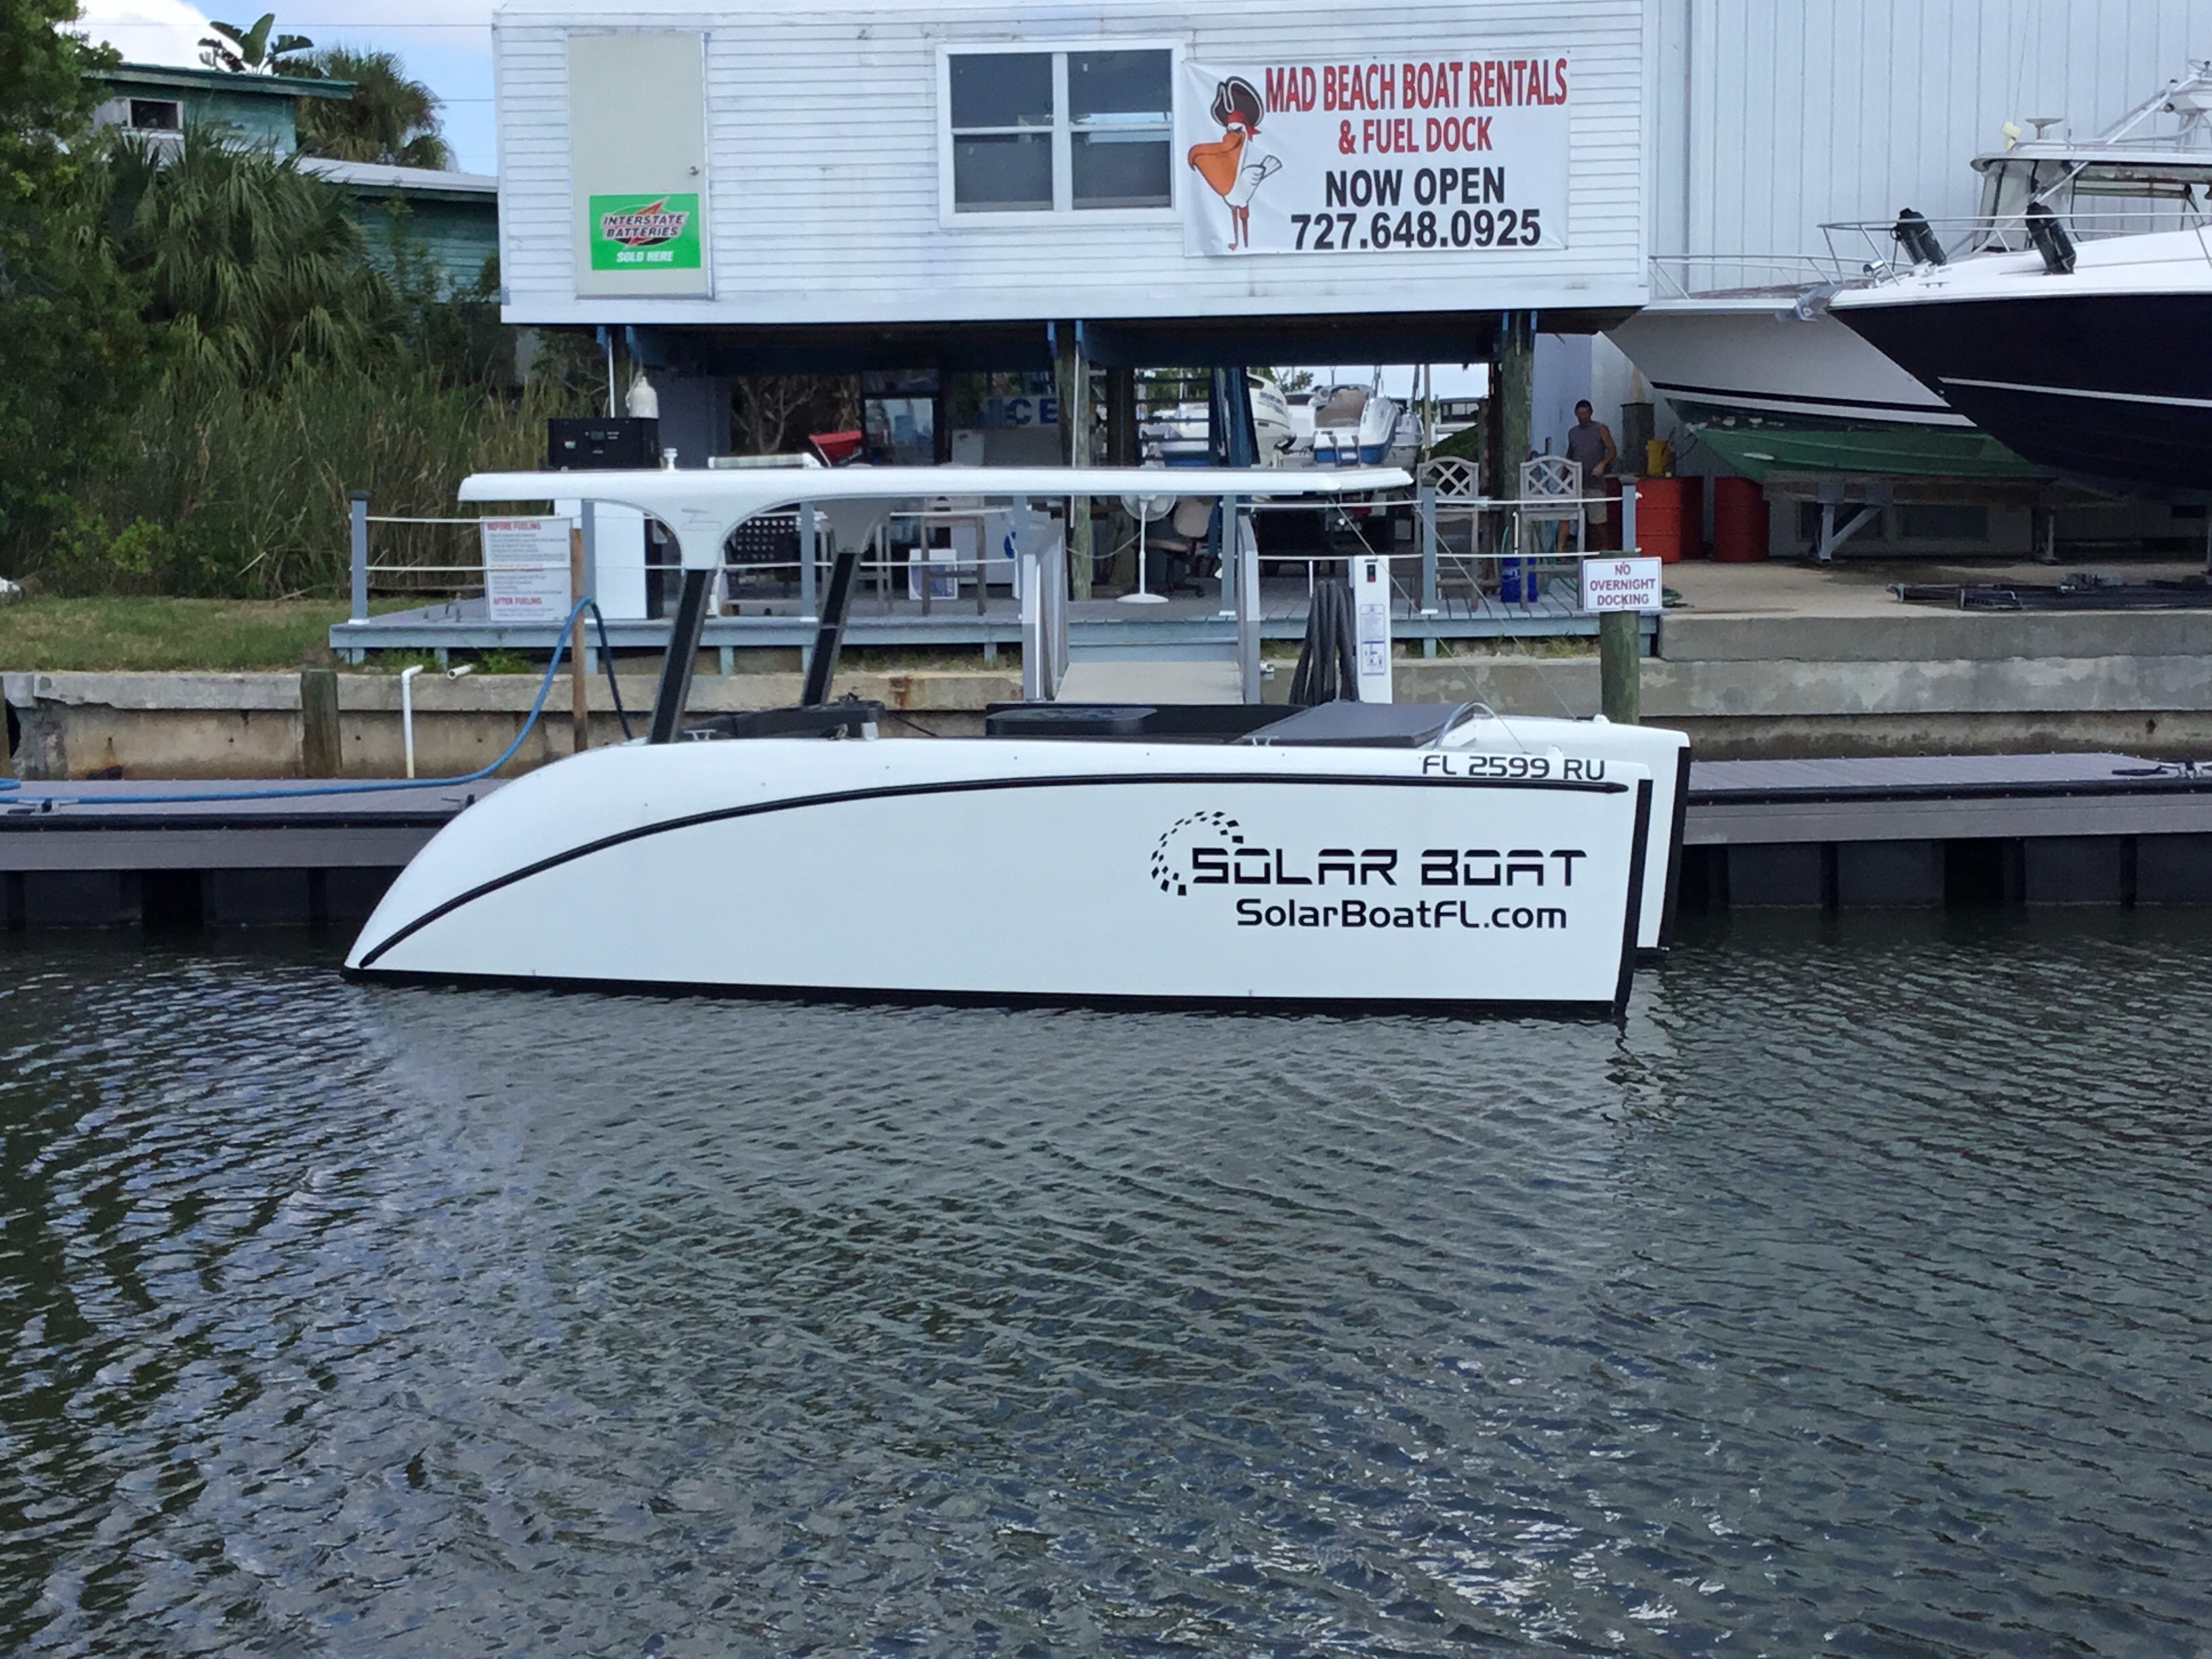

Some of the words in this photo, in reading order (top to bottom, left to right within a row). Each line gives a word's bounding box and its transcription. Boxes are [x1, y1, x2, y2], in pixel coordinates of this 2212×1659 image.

[1265, 66, 1317, 112] MAD
[1323, 63, 1395, 112] BEACH
[1401, 62, 1464, 110] BOAT
[1469, 58, 1568, 106] RENTALS
[1338, 120, 1357, 155] &
[1363, 118, 1420, 154] FUEL
[1426, 116, 1494, 152] DOCK
[1325, 169, 1404, 207] NOW
[1414, 166, 1505, 205] OPEN
[603, 214, 684, 225] INTERSTATE
[607, 226, 679, 238] BATTERIES
[1290, 209, 1542, 251] 727.648.0925
[616, 251, 644, 263] SOLD
[647, 251, 674, 262] HERE
[1614, 564, 1631, 575] NO
[1589, 579, 1656, 592] OVERNIGHT
[1597, 594, 1650, 606] DOCKING
[1422, 754, 1457, 775] FL
[1468, 755, 1551, 779] 2599
[1563, 758, 1605, 781] RU
[1192, 847, 1397, 886] SOLAR
[1420, 848, 1587, 886] BOAT
[1236, 898, 1568, 929] SolarBoatFL.com
